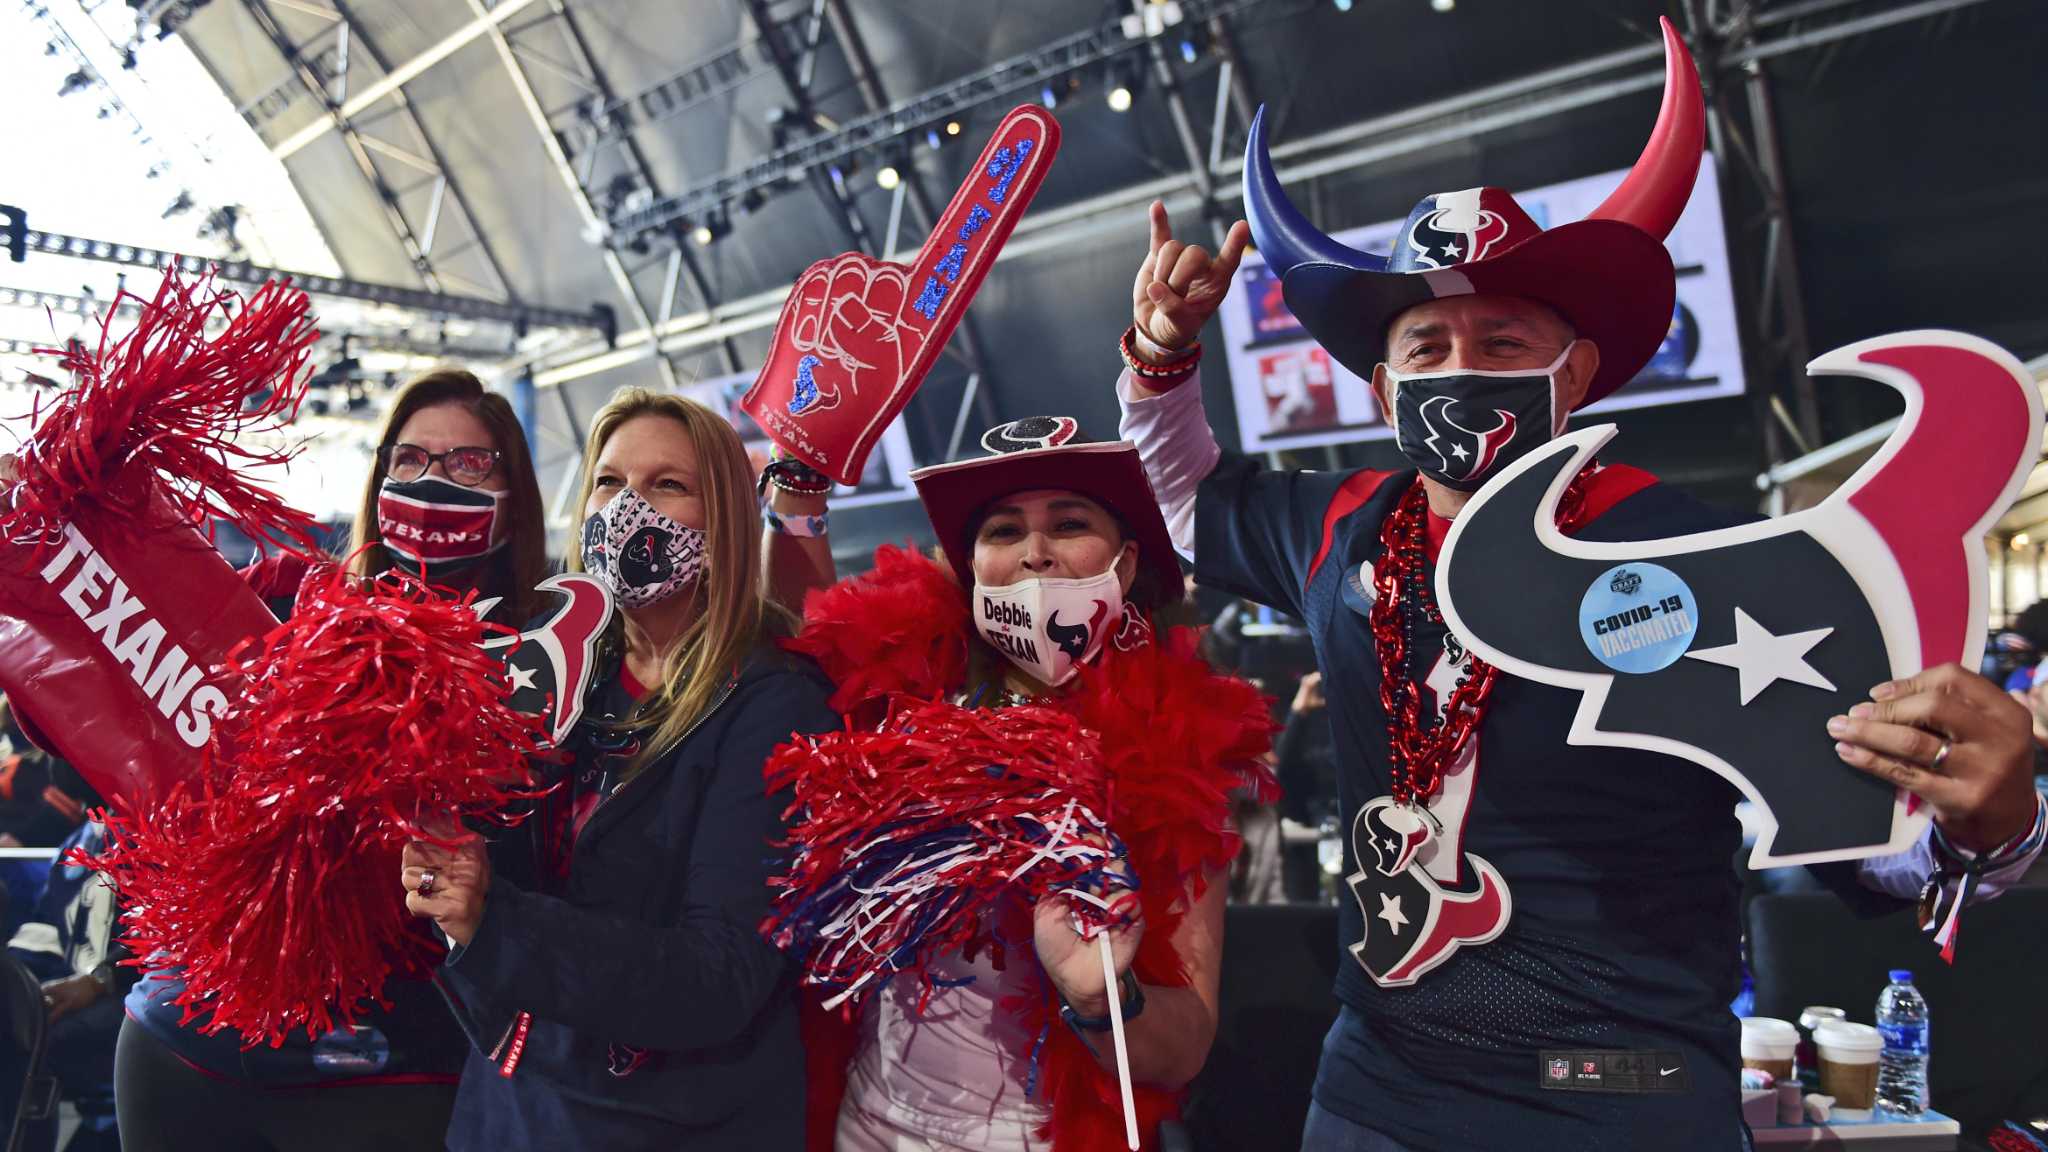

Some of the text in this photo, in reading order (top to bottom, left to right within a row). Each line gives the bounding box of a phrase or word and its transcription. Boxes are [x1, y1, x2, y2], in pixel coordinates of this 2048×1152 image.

[913, 204, 992, 320] FAN
[761, 402, 828, 464] TEXANS
[383, 518, 482, 544] TEXANS
[40, 522, 229, 748] TEXANS
[984, 597, 1032, 630] Debbie
[1592, 595, 1683, 635] COVID-19
[1597, 611, 1692, 658] VACCINATED
[986, 629, 1040, 664] TEXAN
